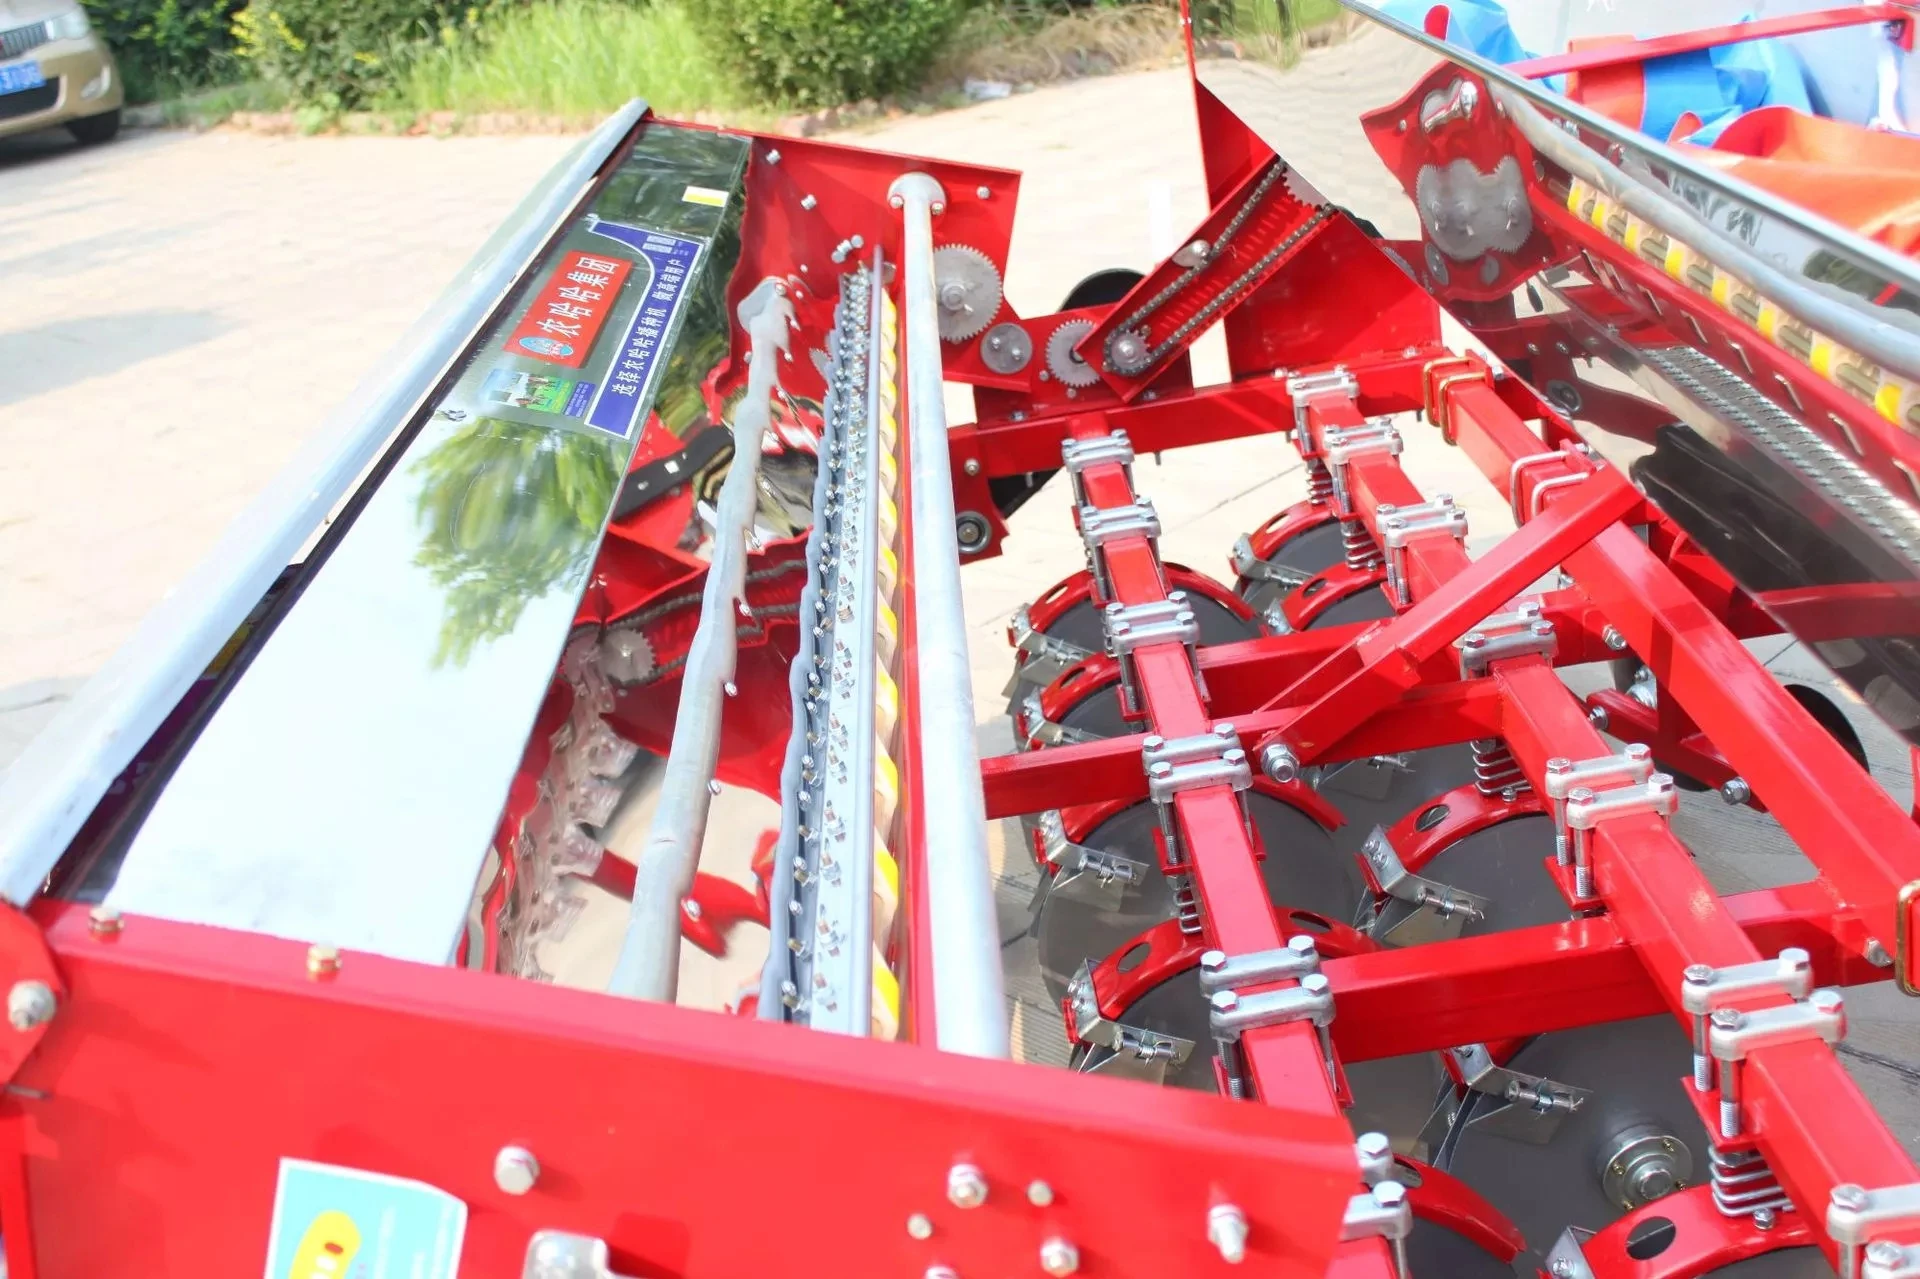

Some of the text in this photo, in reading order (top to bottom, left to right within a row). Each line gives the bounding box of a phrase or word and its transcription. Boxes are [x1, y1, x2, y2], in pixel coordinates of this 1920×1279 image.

[536, 257, 619, 338] 农哈哈集团
[612, 308, 667, 397] 选择农哈哈播种机
